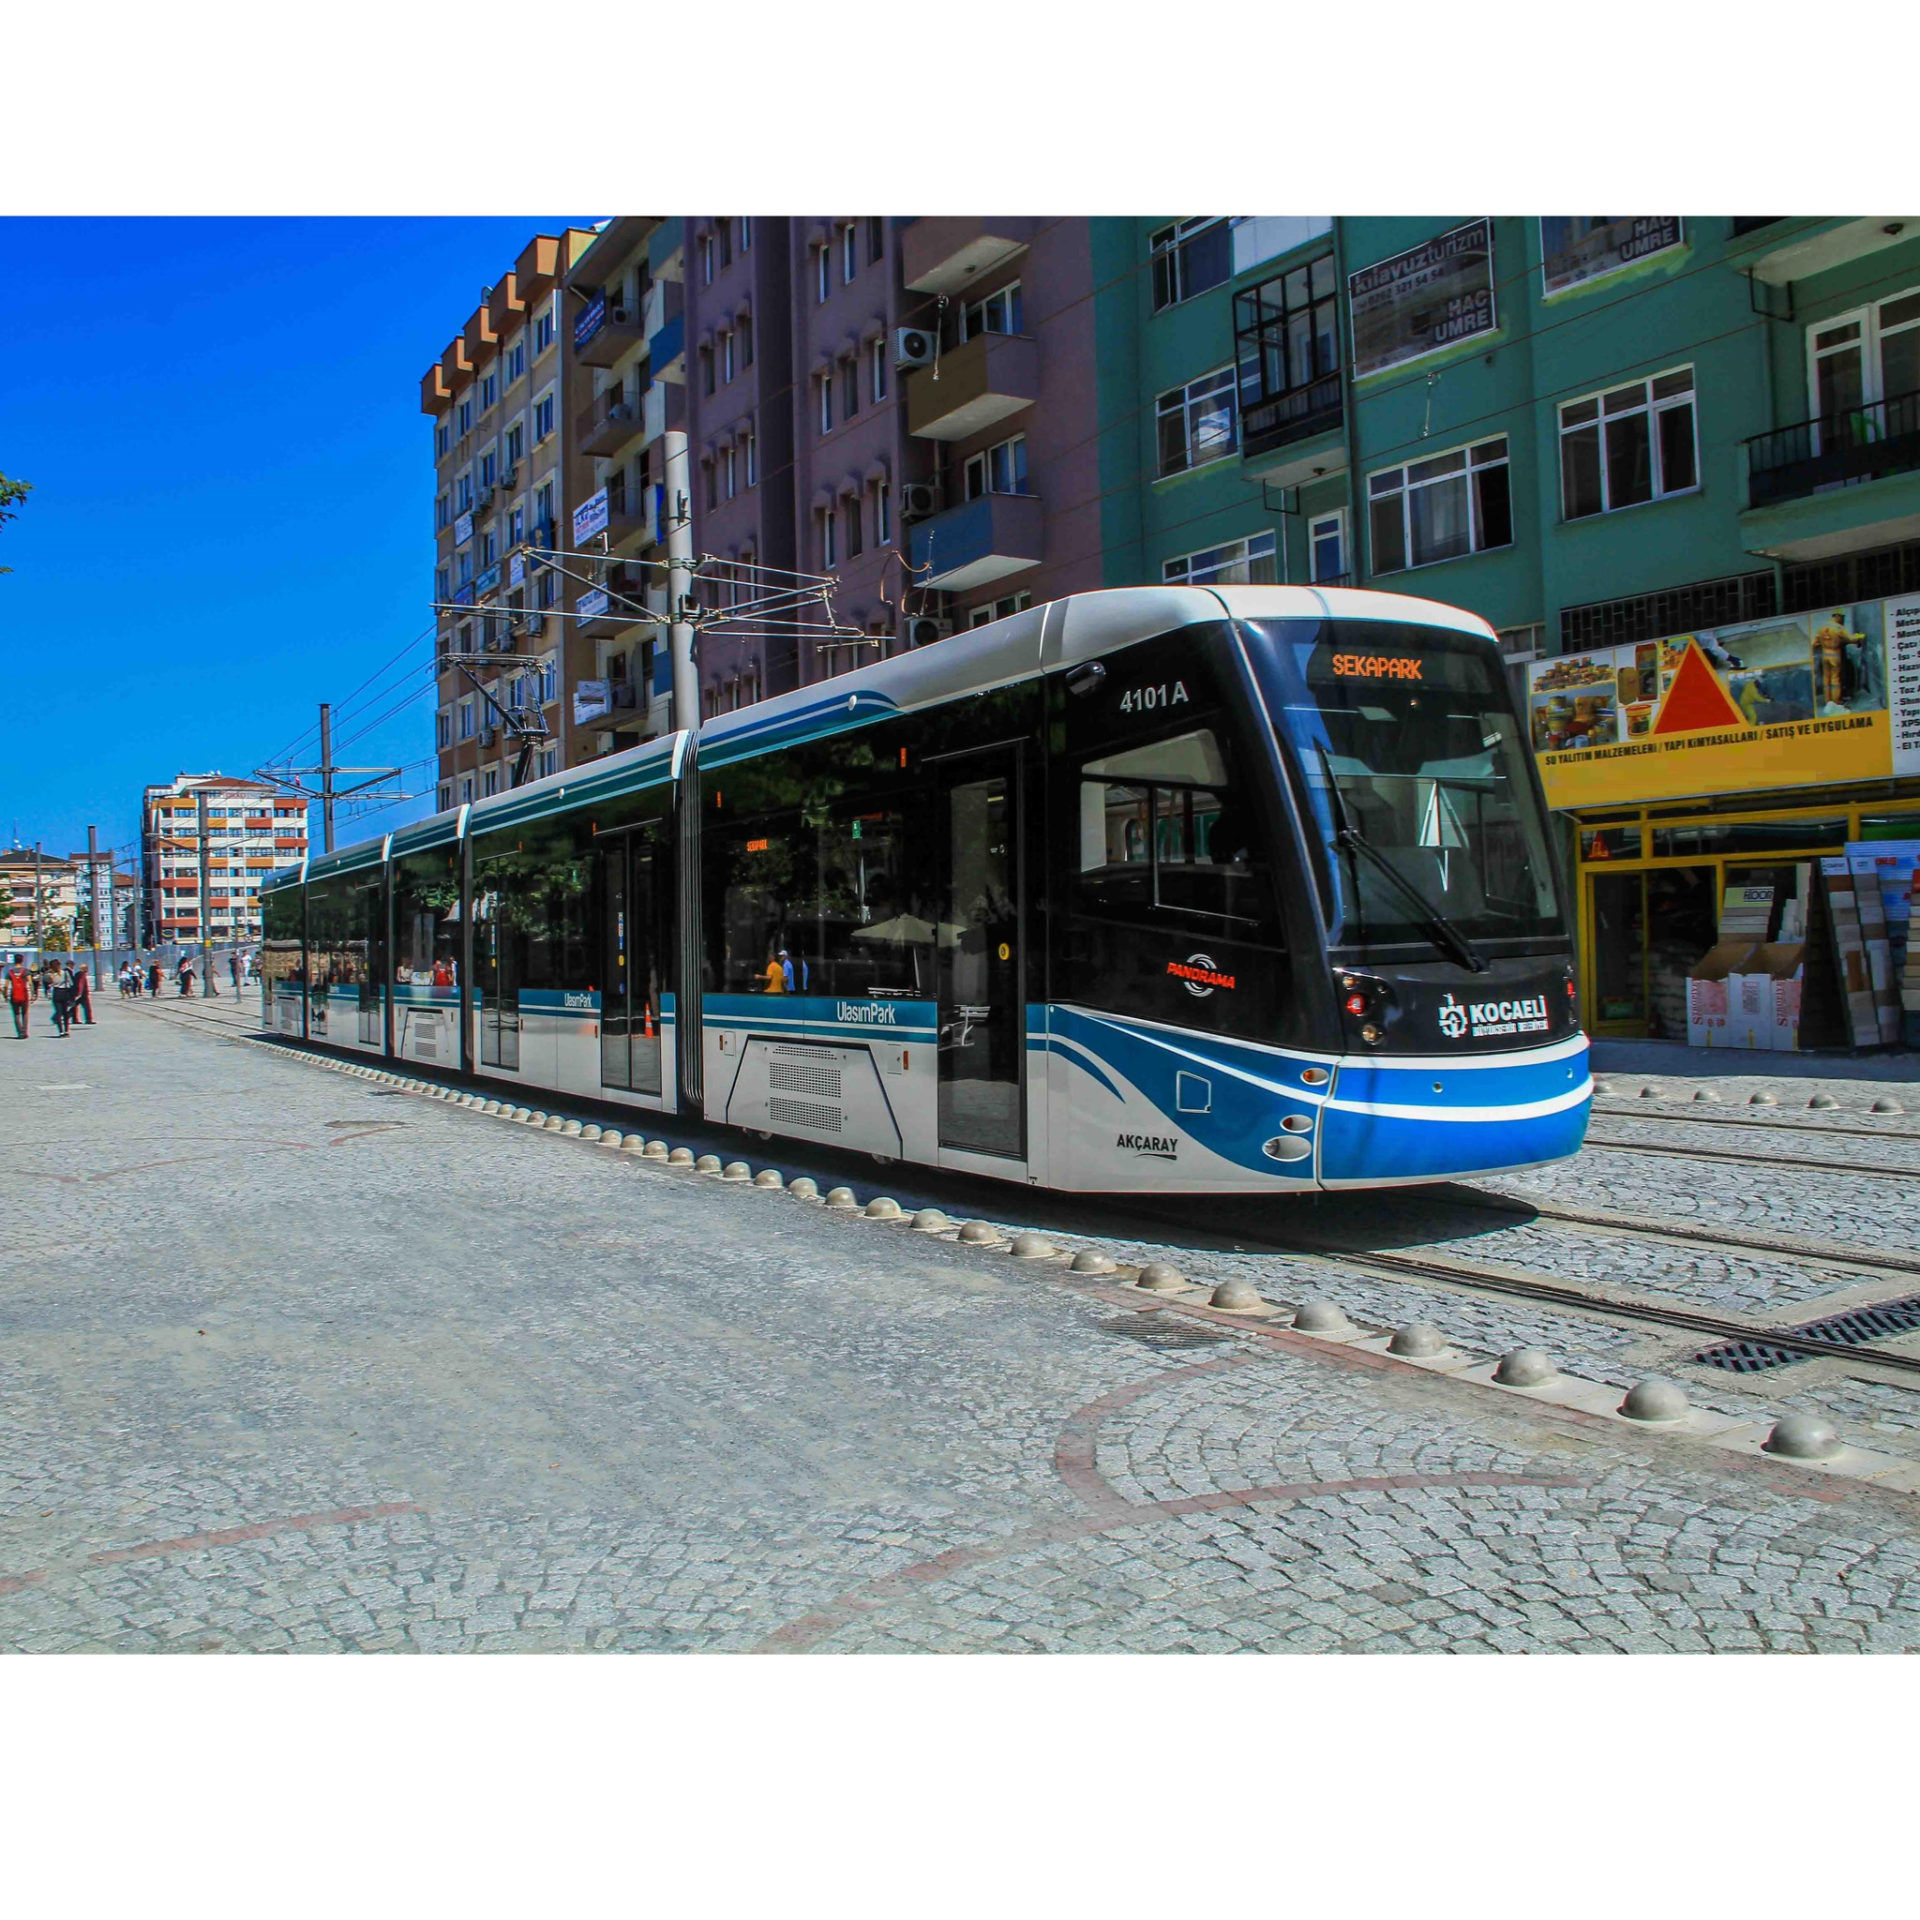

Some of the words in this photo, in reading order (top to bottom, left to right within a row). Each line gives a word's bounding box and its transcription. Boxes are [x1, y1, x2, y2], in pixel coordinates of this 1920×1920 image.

[1622, 227, 1674, 262] UMRE
[1435, 308, 1489, 342] UMRE
[1332, 653, 1423, 680] SEKAPARK
[1545, 755, 1557, 765] SU
[1558, 750, 1593, 764] YALITIM
[1664, 739, 1686, 752] YAPI
[1797, 727, 1811, 736] VE
[1166, 962, 1236, 989] PANORAMA
[1116, 1134, 1179, 1152] AKÇARAY
